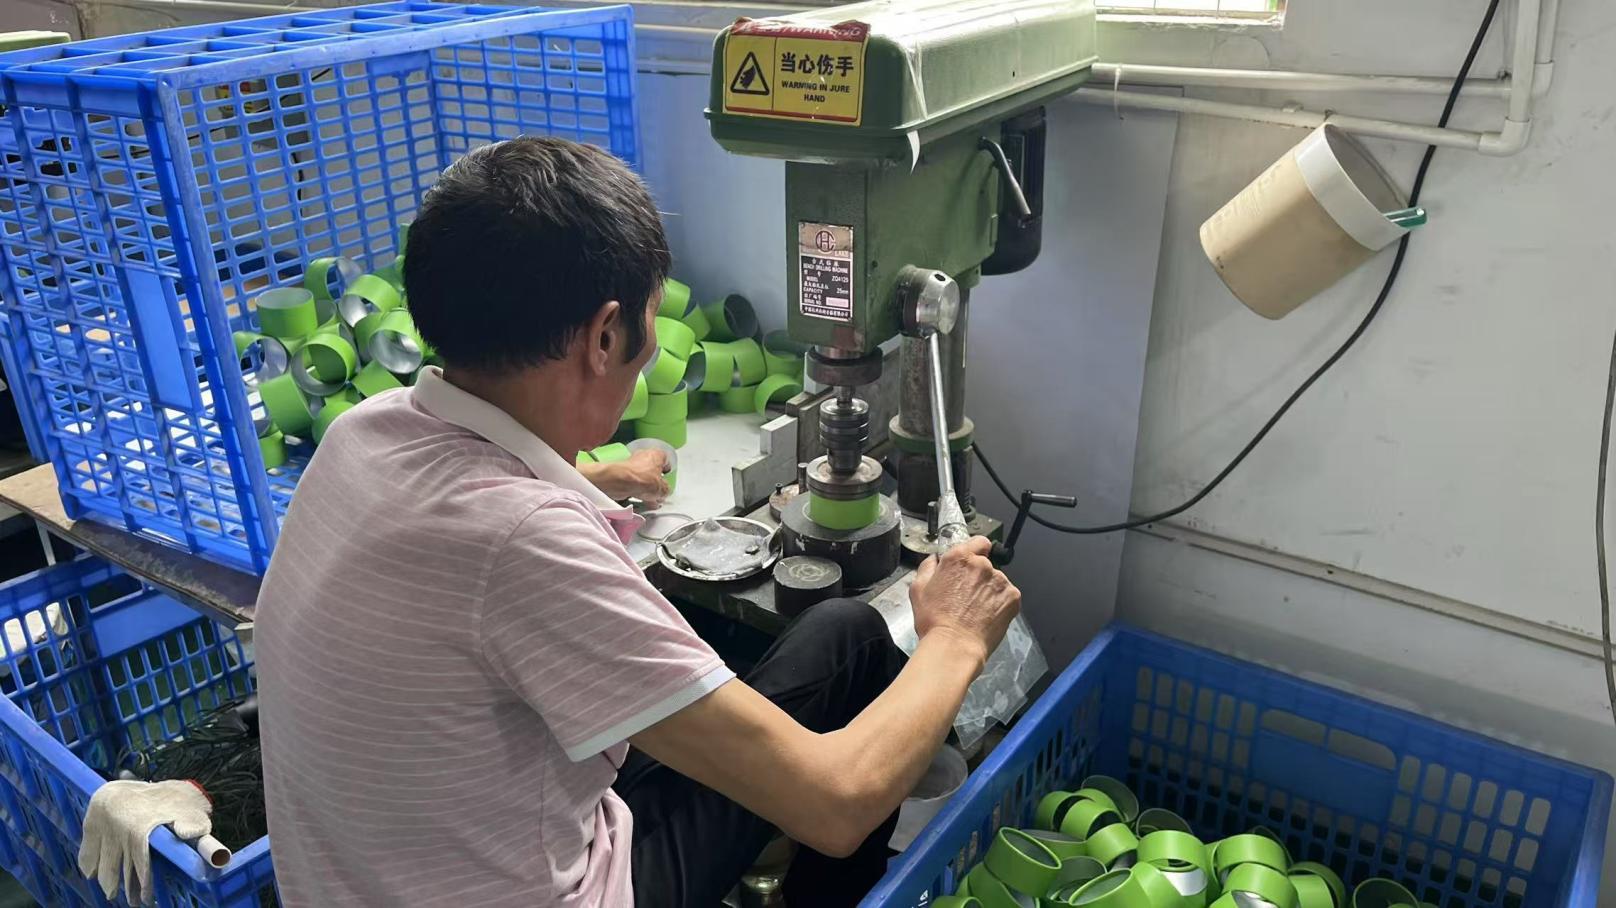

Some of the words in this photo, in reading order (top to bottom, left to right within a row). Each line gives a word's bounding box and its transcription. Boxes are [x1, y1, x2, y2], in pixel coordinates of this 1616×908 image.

[780, 51, 854, 77] 当心伤手
[781, 80, 817, 91] WARNING
[819, 82, 828, 91] IN
[830, 84, 850, 93] JURE
[803, 93, 825, 103] HAND
